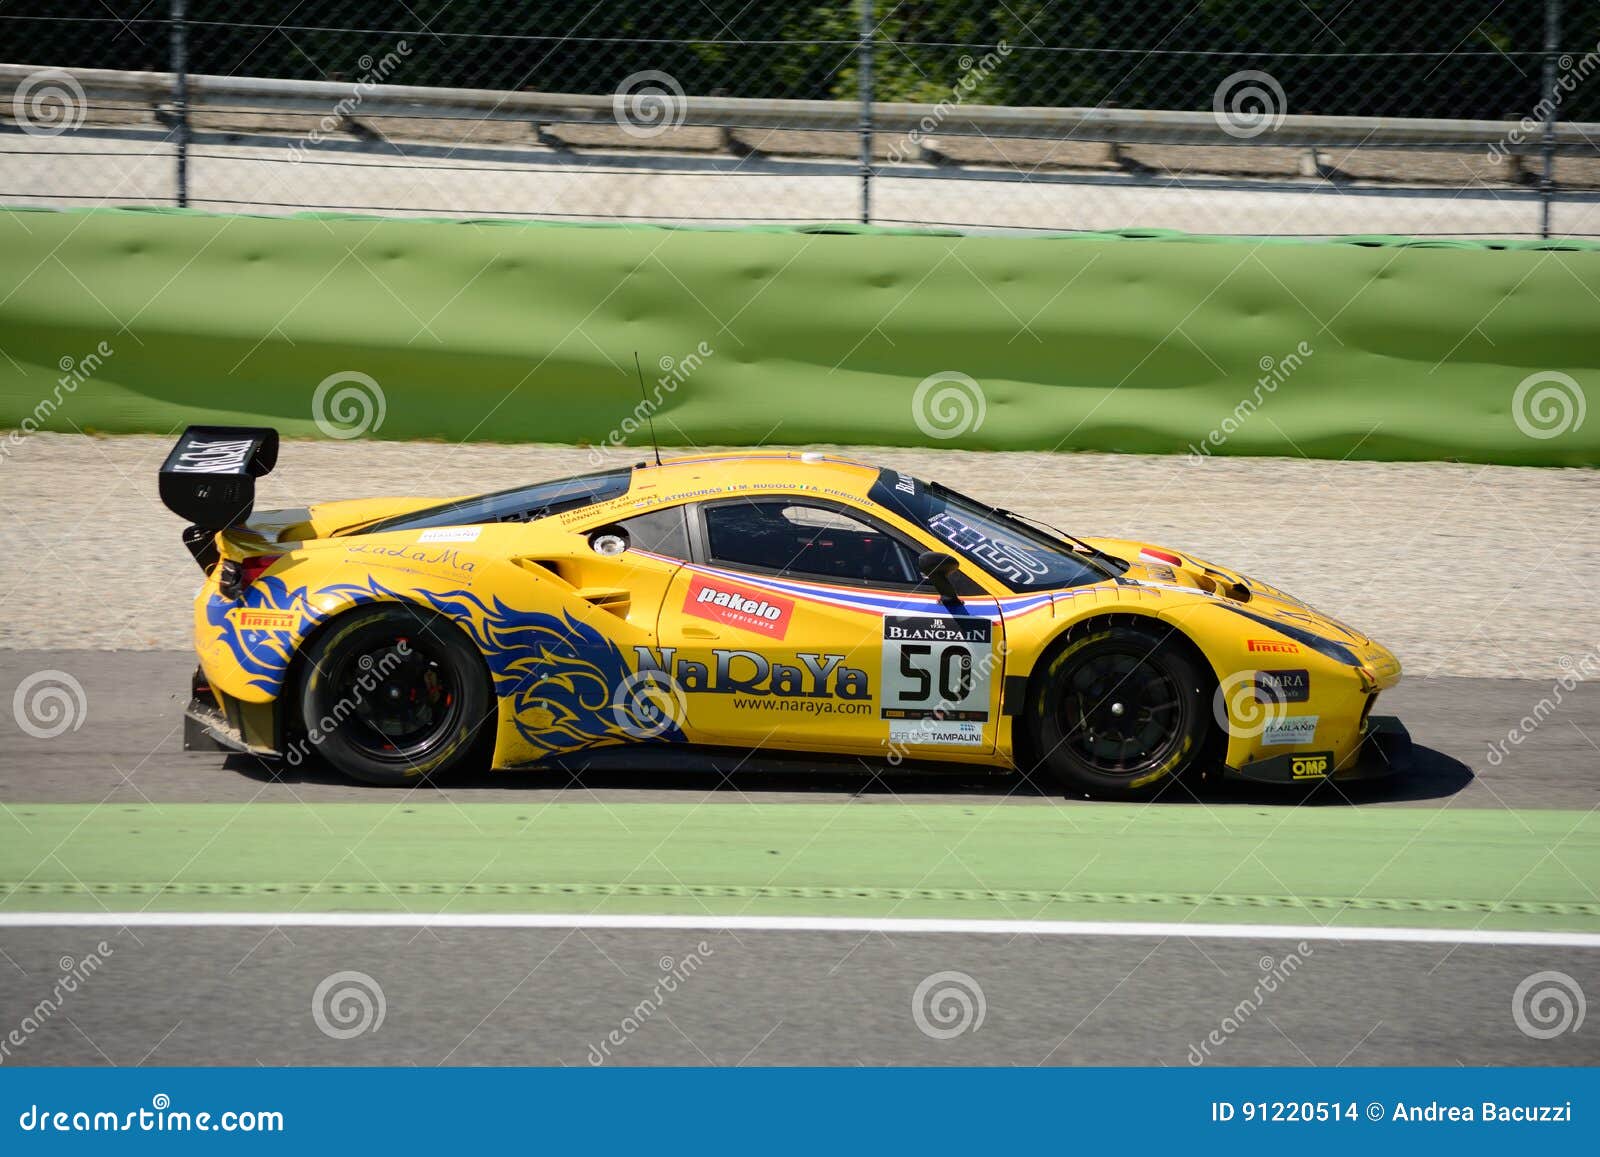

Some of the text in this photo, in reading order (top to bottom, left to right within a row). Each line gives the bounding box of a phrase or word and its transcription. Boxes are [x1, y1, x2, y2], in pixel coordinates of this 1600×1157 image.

[696, 586, 782, 622] pakelo
[240, 612, 293, 627] PIRELLI
[721, 611, 775, 630] LUBRICANTS
[889, 626, 986, 641] BLANCPAIN
[1247, 639, 1299, 654] PIRELLI
[899, 644, 972, 702] 50
[1262, 674, 1304, 688] NARA
[733, 698, 872, 716] www.naraya.com
[931, 732, 981, 742] TAMPALINI
[1292, 760, 1328, 777] OMP
